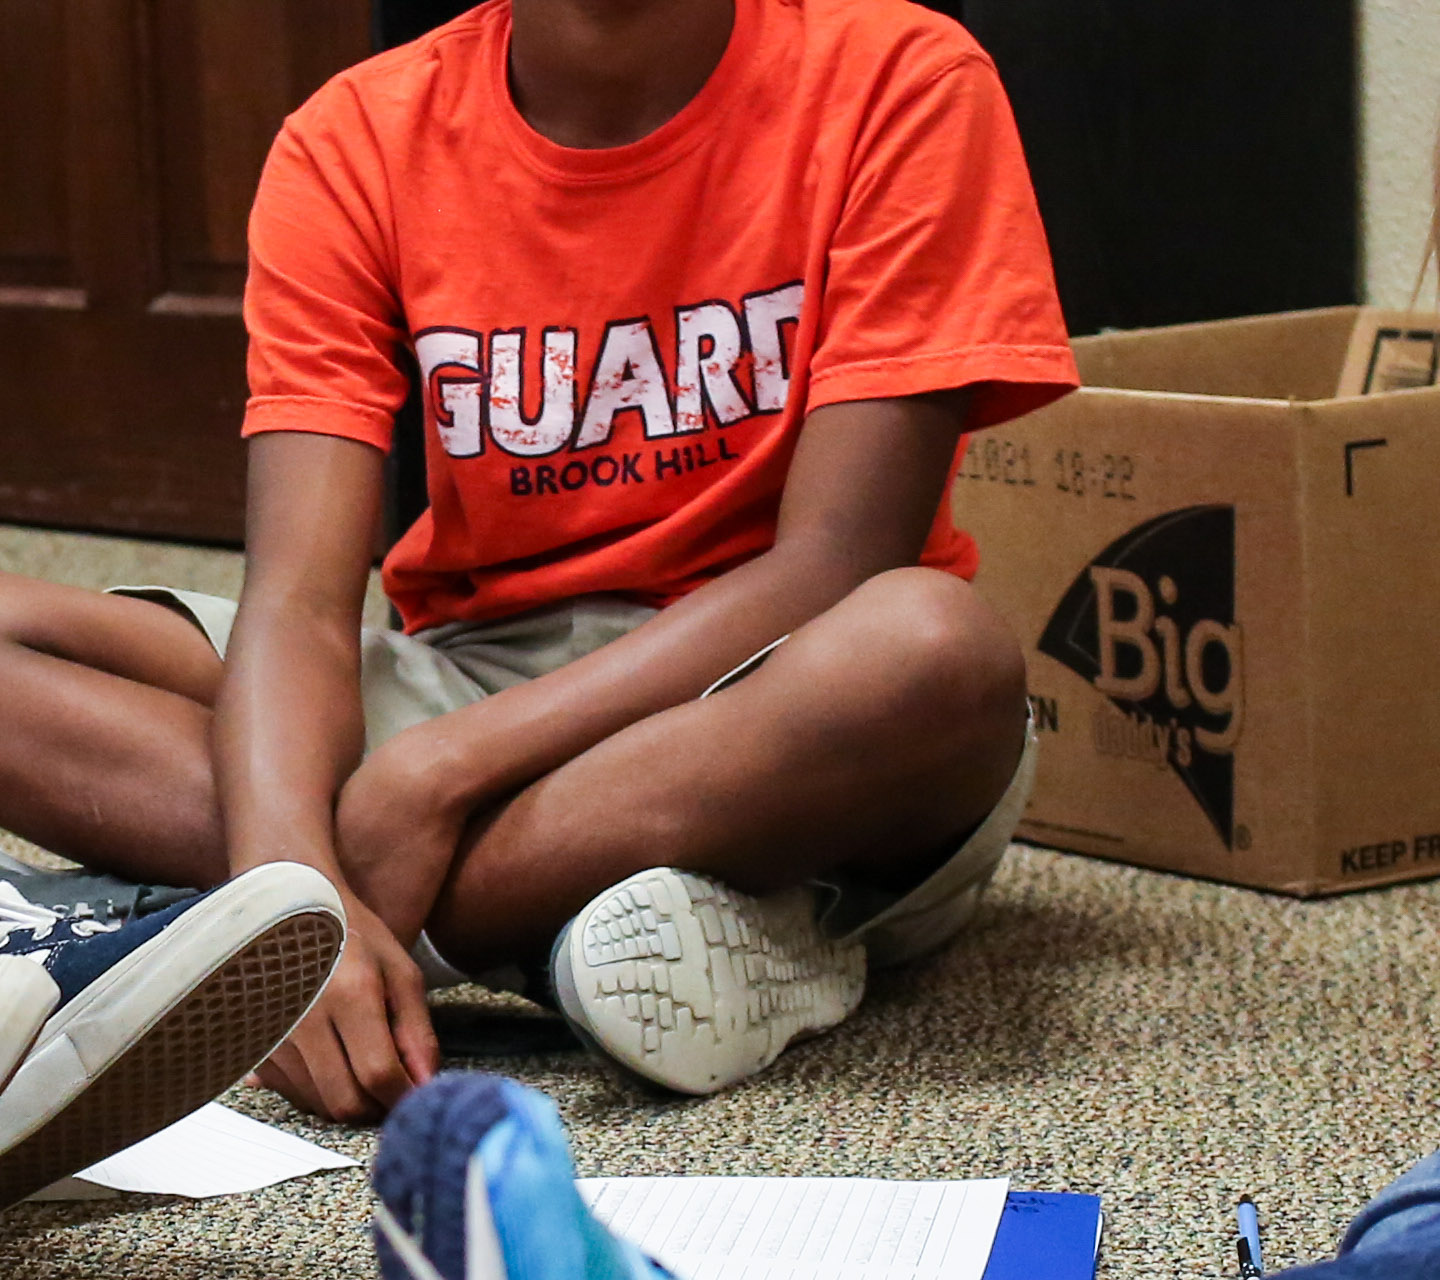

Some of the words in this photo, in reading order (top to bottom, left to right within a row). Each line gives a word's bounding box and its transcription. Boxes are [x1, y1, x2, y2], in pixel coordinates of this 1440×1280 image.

[415, 280, 807, 460] GUARD
[510, 454, 643, 496] BROOK
[655, 437, 739, 481] HILL
[1090, 565, 1246, 756] Big
[1340, 839, 1406, 876] KEEP
